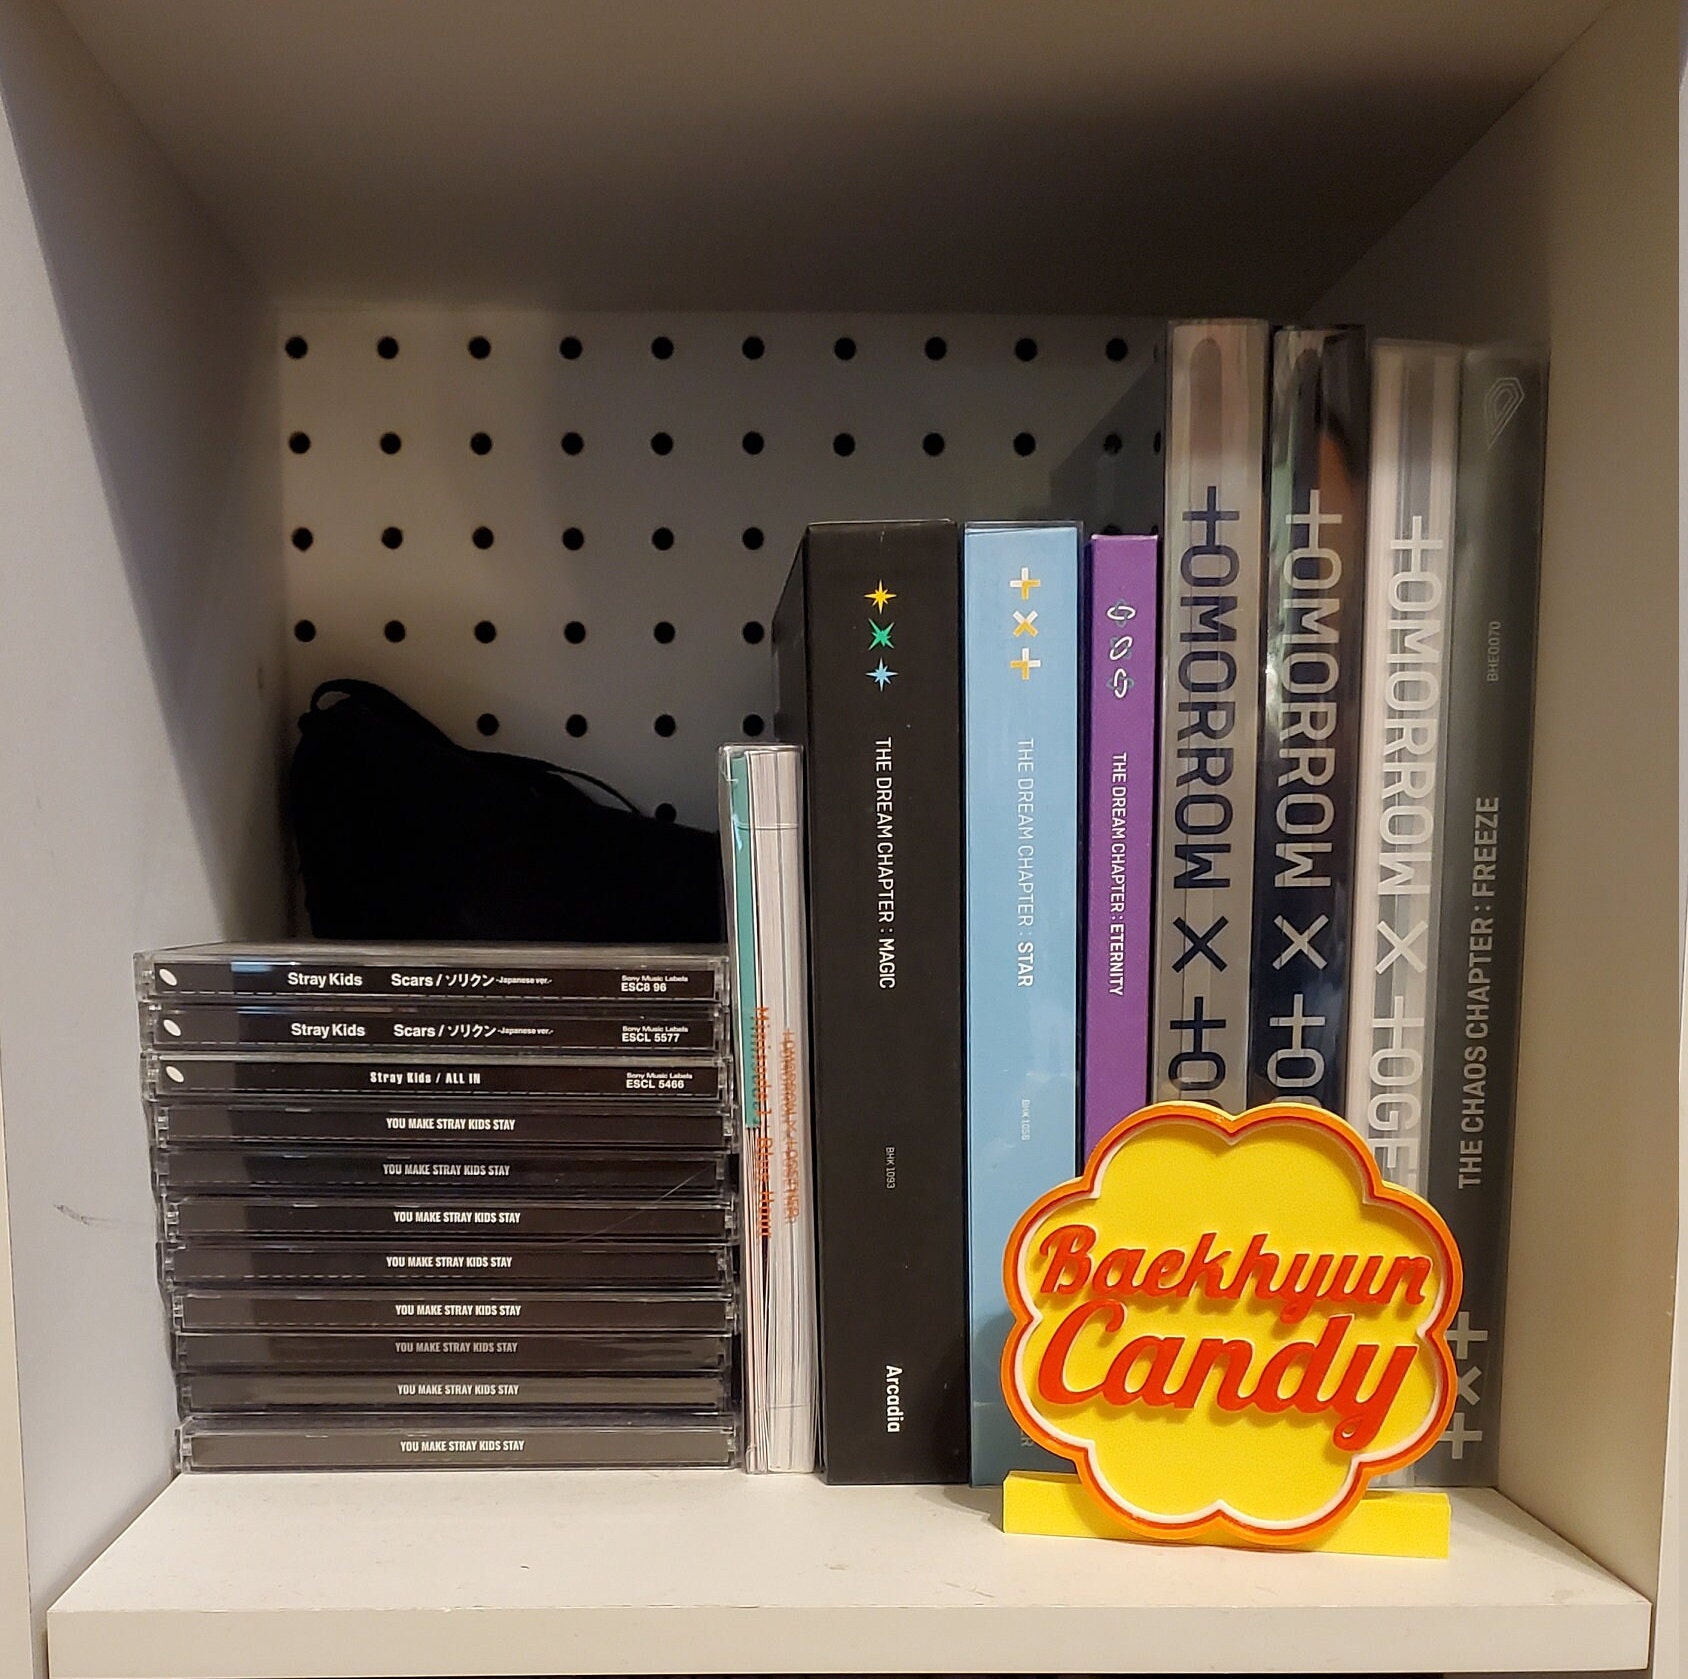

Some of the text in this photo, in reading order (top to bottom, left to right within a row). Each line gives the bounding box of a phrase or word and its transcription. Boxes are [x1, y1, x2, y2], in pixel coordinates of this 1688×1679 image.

[1486, 621, 1501, 682] BHE0070
[1173, 486, 1240, 889] TOMORROW
[1274, 489, 1343, 887] TOMORROW
[1378, 515, 1444, 895] TOMORROW
[875, 737, 892, 772] THE
[1017, 738, 1034, 772] THE
[1112, 752, 1127, 783] THE
[876, 777, 894, 839] DREAM
[1017, 778, 1034, 839] DREAM
[1111, 786, 1126, 839] DREAM
[1472, 796, 1500, 897] FREEZE
[877, 843, 895, 923] CHAPTER
[1017, 845, 1034, 927] CHAPTER
[1110, 843, 1126, 913] CHAPTER
[879, 937, 896, 989] MAGIC
[1017, 941, 1034, 987] STAR
[1108, 923, 1125, 996] ETERNITY
[1172, 916, 1228, 973] X
[1272, 914, 1329, 971] X
[1375, 920, 1428, 975] X
[288, 972, 326, 988] Stray
[329, 972, 363, 986] Kids
[391, 974, 433, 987] Scars
[446, 973, 495, 988] ソリクン
[621, 974, 640, 982] Sony
[621, 982, 666, 992] ESC8 96
[1465, 914, 1494, 1039] CHAPTER
[291, 1023, 330, 1038] Stray
[332, 1024, 366, 1036] Kids
[393, 1024, 436, 1038] Scars
[448, 1024, 497, 1038] ソリクン
[622, 1033, 680, 1042] ESCL 5577
[370, 1072, 402, 1084] Stray
[407, 1072, 432, 1084] Kids
[445, 1072, 465, 1084] ALL
[469, 1073, 481, 1084] IN
[626, 1072, 645, 1080] Sony
[626, 1080, 684, 1088] ESCL 5466
[1460, 1046, 1488, 1133] CHAOS
[386, 1118, 516, 1130] YOU MAKE STRAY KIDS STAY
[383, 1164, 510, 1176] YOU MAKE STRAY KIDS STAY
[886, 1146, 896, 1189] BHK 1093
[1458, 1139, 1484, 1189] THE
[394, 1211, 521, 1223] YOU MAKE STRAY KIDS STAY
[386, 1256, 512, 1267] YOU MAKE STRAY KIDS STAY
[1039, 1223, 1433, 1325] Baekhyun
[395, 1305, 521, 1316] YOU MAKE STRAY KIDS STAY
[395, 1342, 518, 1352] YOU MAKE STRAY KIDS STAY
[397, 1384, 519, 1395] YOU MAKE STRAY KIDS STAY
[886, 1364, 903, 1433] Arcadia
[1036, 1299, 1419, 1453] Candy
[400, 1440, 525, 1452] YOU MAKE STRAY KIDS STAY
